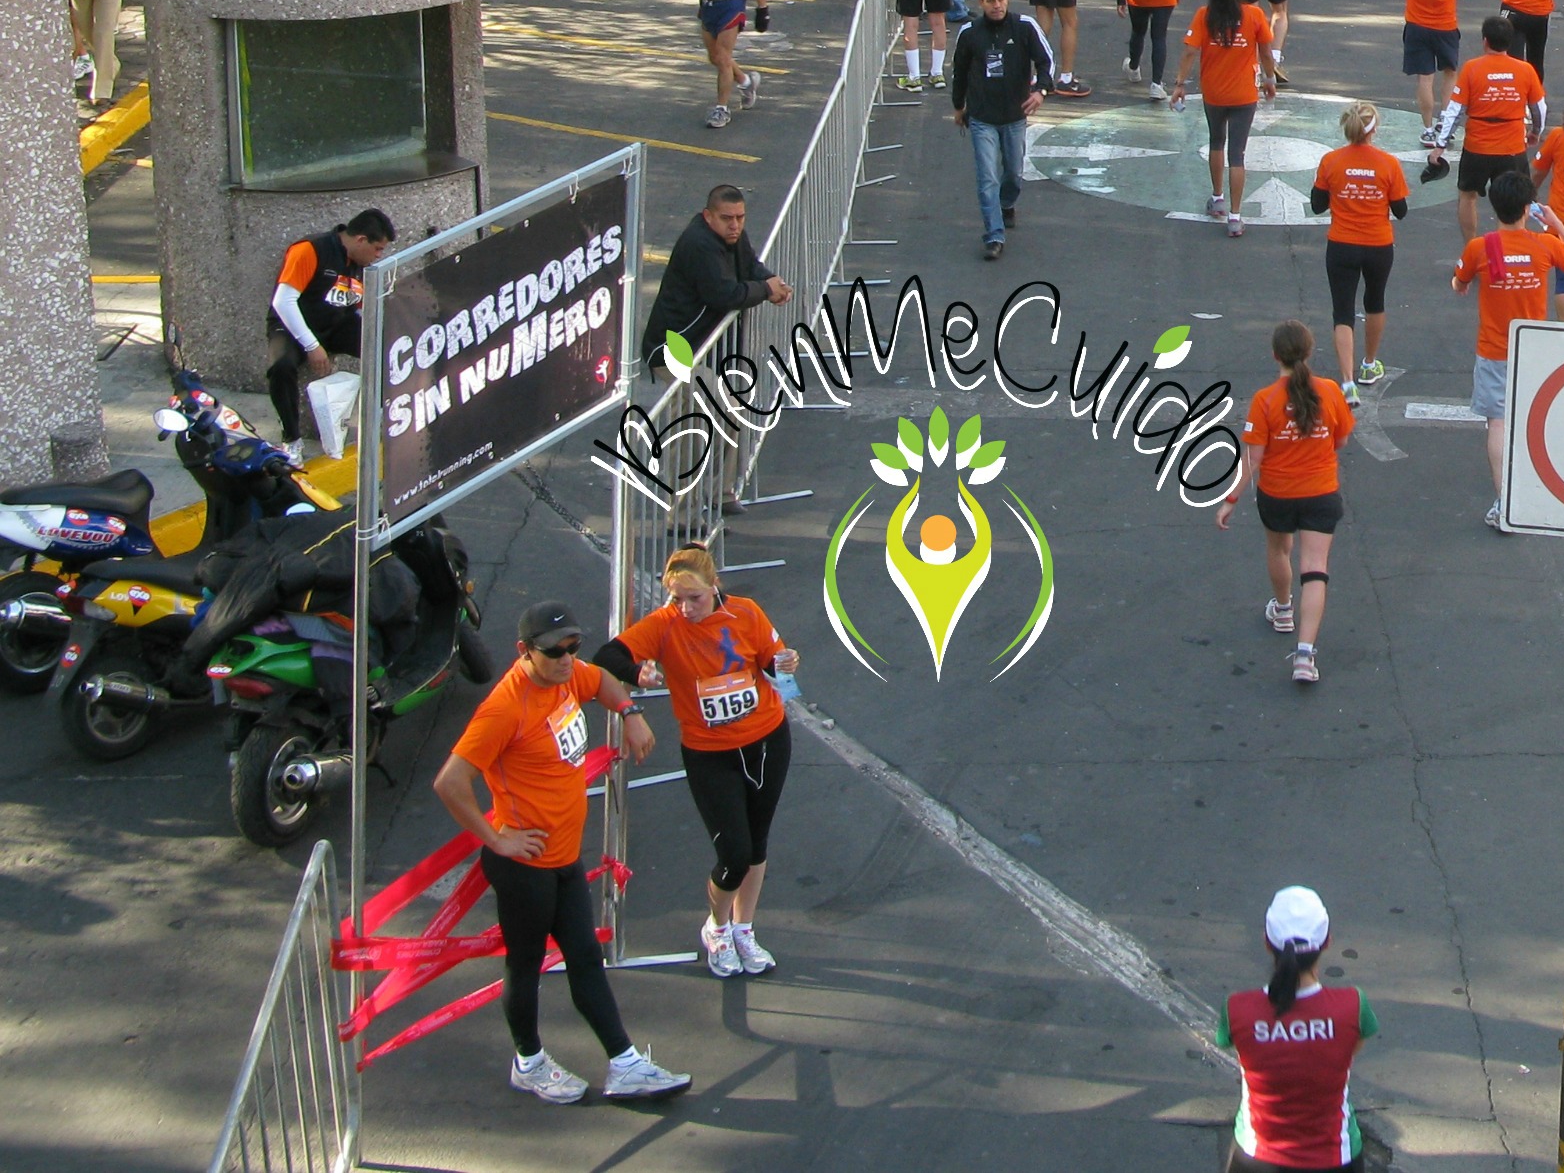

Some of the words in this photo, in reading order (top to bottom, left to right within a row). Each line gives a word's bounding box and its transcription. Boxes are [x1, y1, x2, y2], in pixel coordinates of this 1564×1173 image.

[1487, 72, 1514, 80] CORRE
[1345, 168, 1375, 177] CORRE
[1504, 255, 1531, 263] ORRE
[389, 225, 622, 386] CORREDORES
[388, 376, 451, 438] SIN
[394, 441, 493, 505] www.totalrunning.com
[702, 690, 755, 719] 5159
[1254, 1017, 1334, 1042] SAGRI
